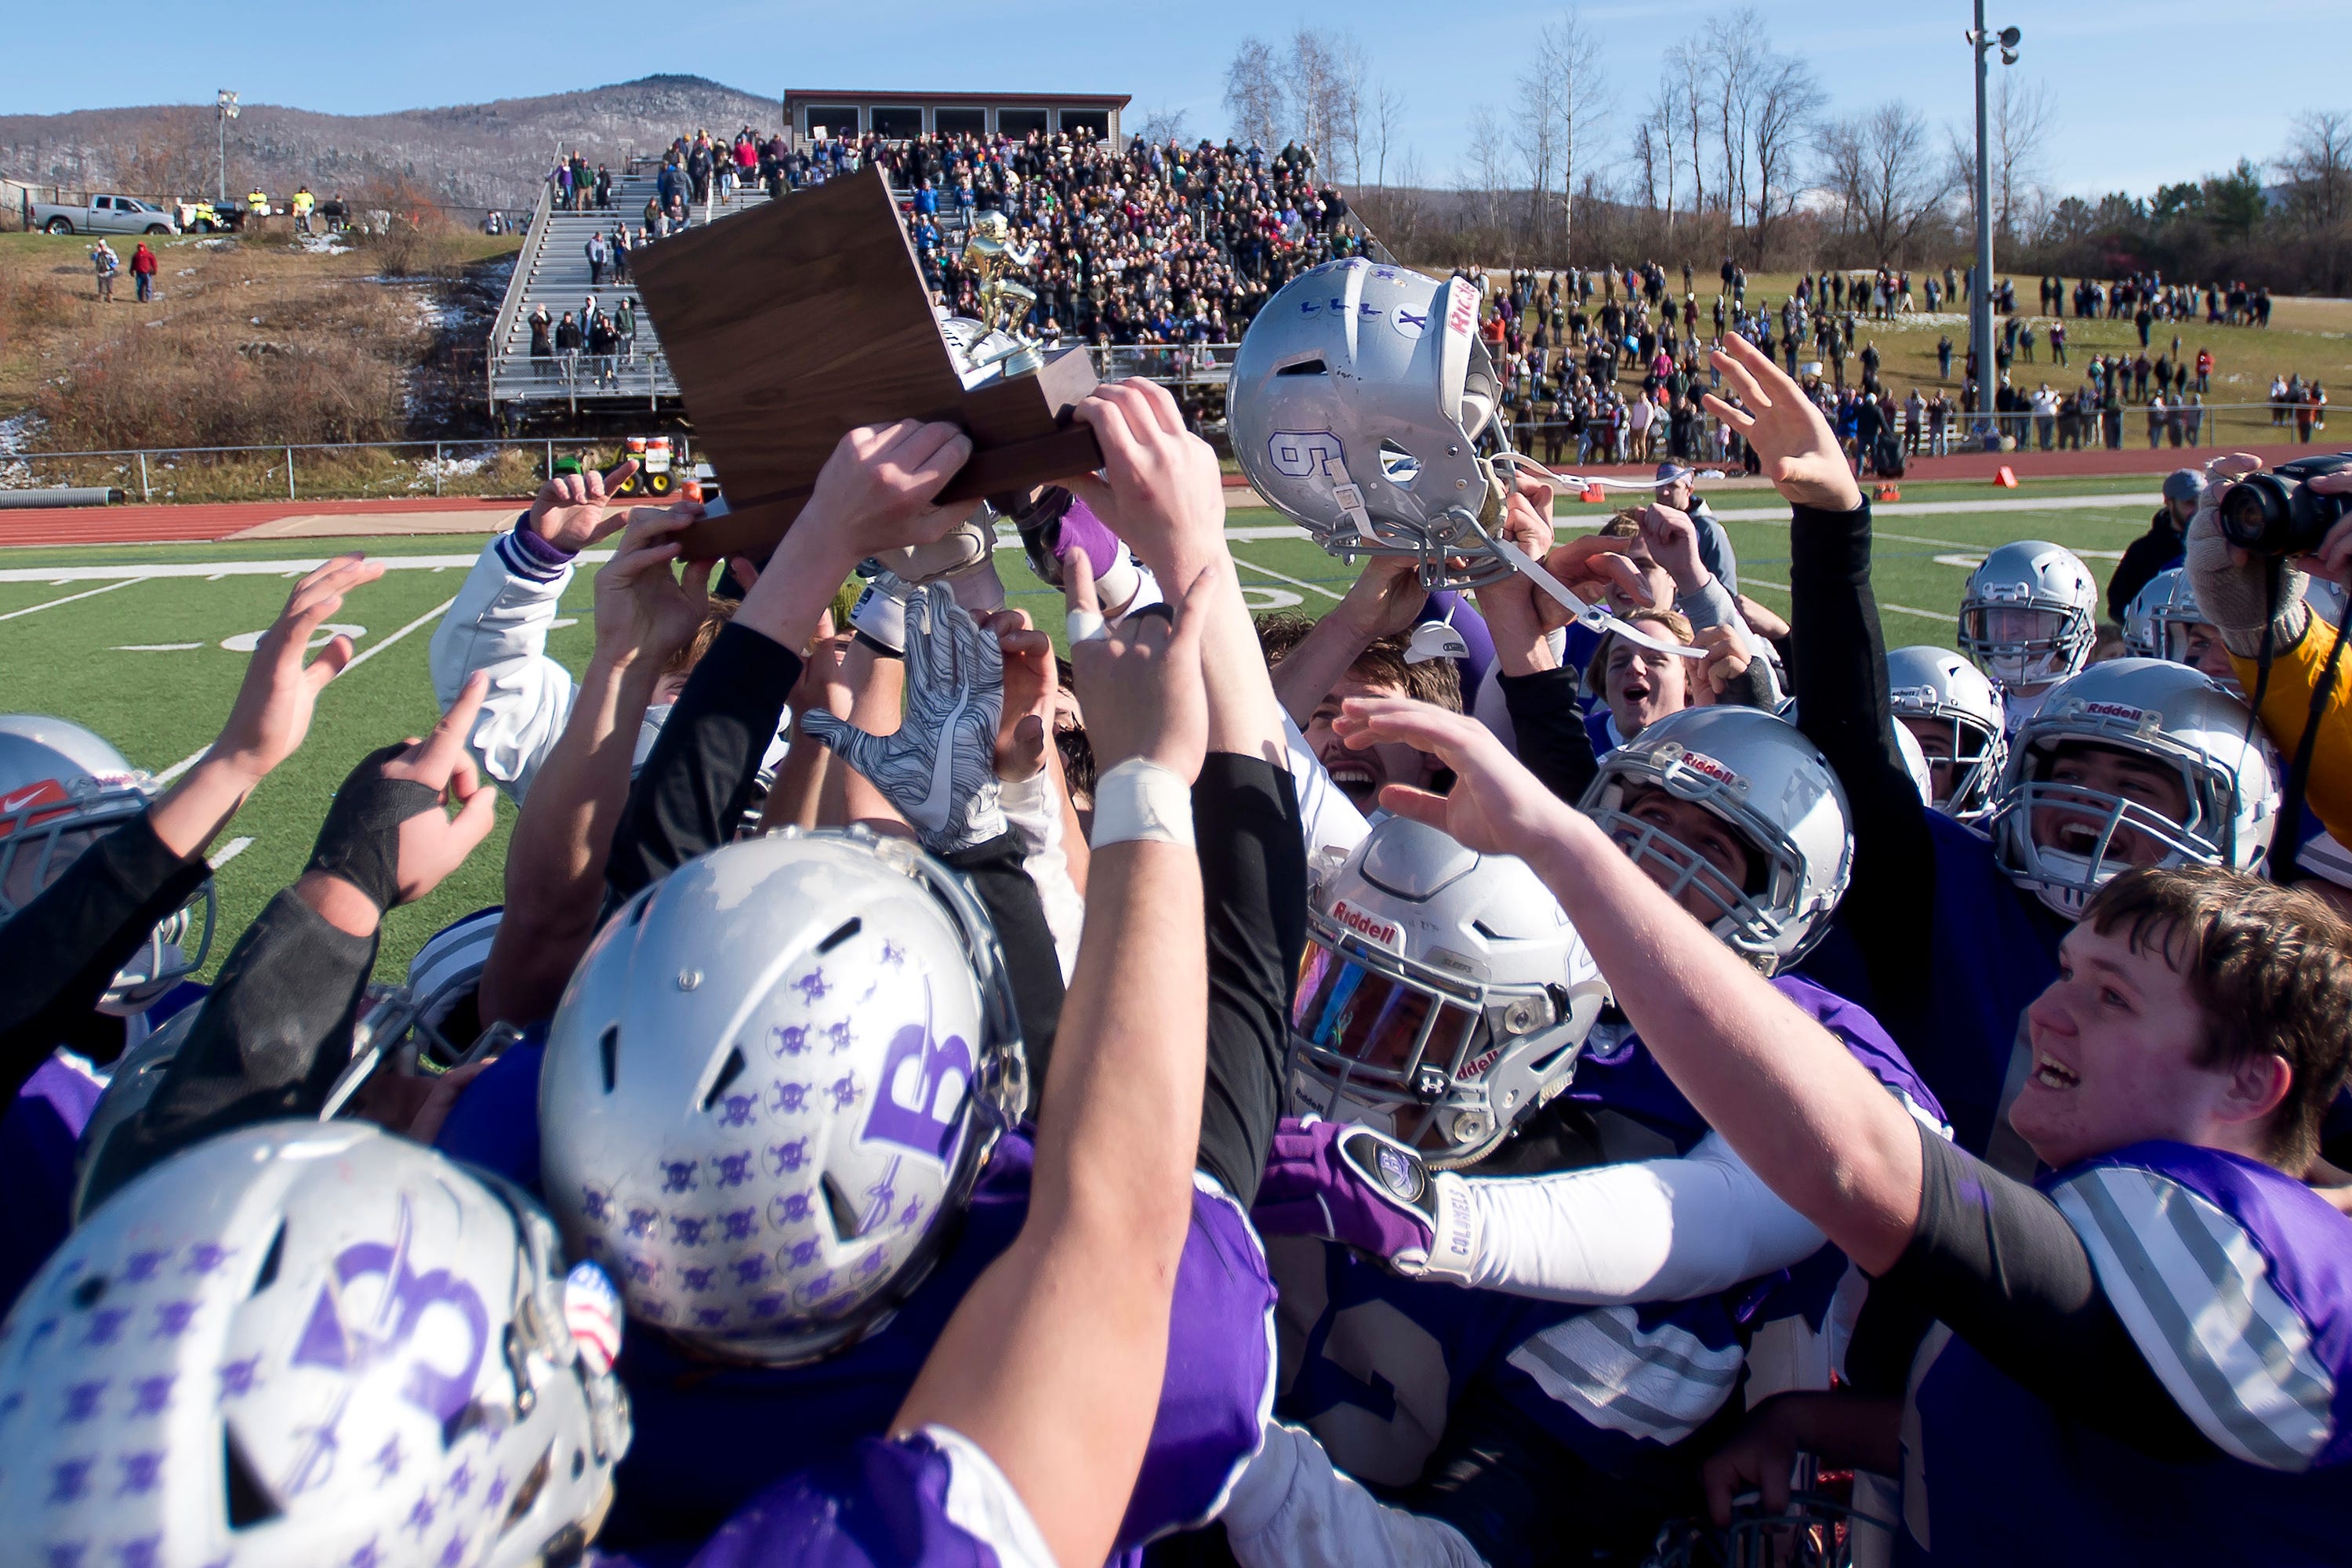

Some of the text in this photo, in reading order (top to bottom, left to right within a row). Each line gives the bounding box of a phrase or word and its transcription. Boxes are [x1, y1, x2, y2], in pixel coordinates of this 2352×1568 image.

[2087, 702, 2143, 721] Riddell
[1682, 752, 1734, 785] Riddell
[1333, 901, 1396, 945] Riddell
[1457, 1049, 1499, 1081] ddell
